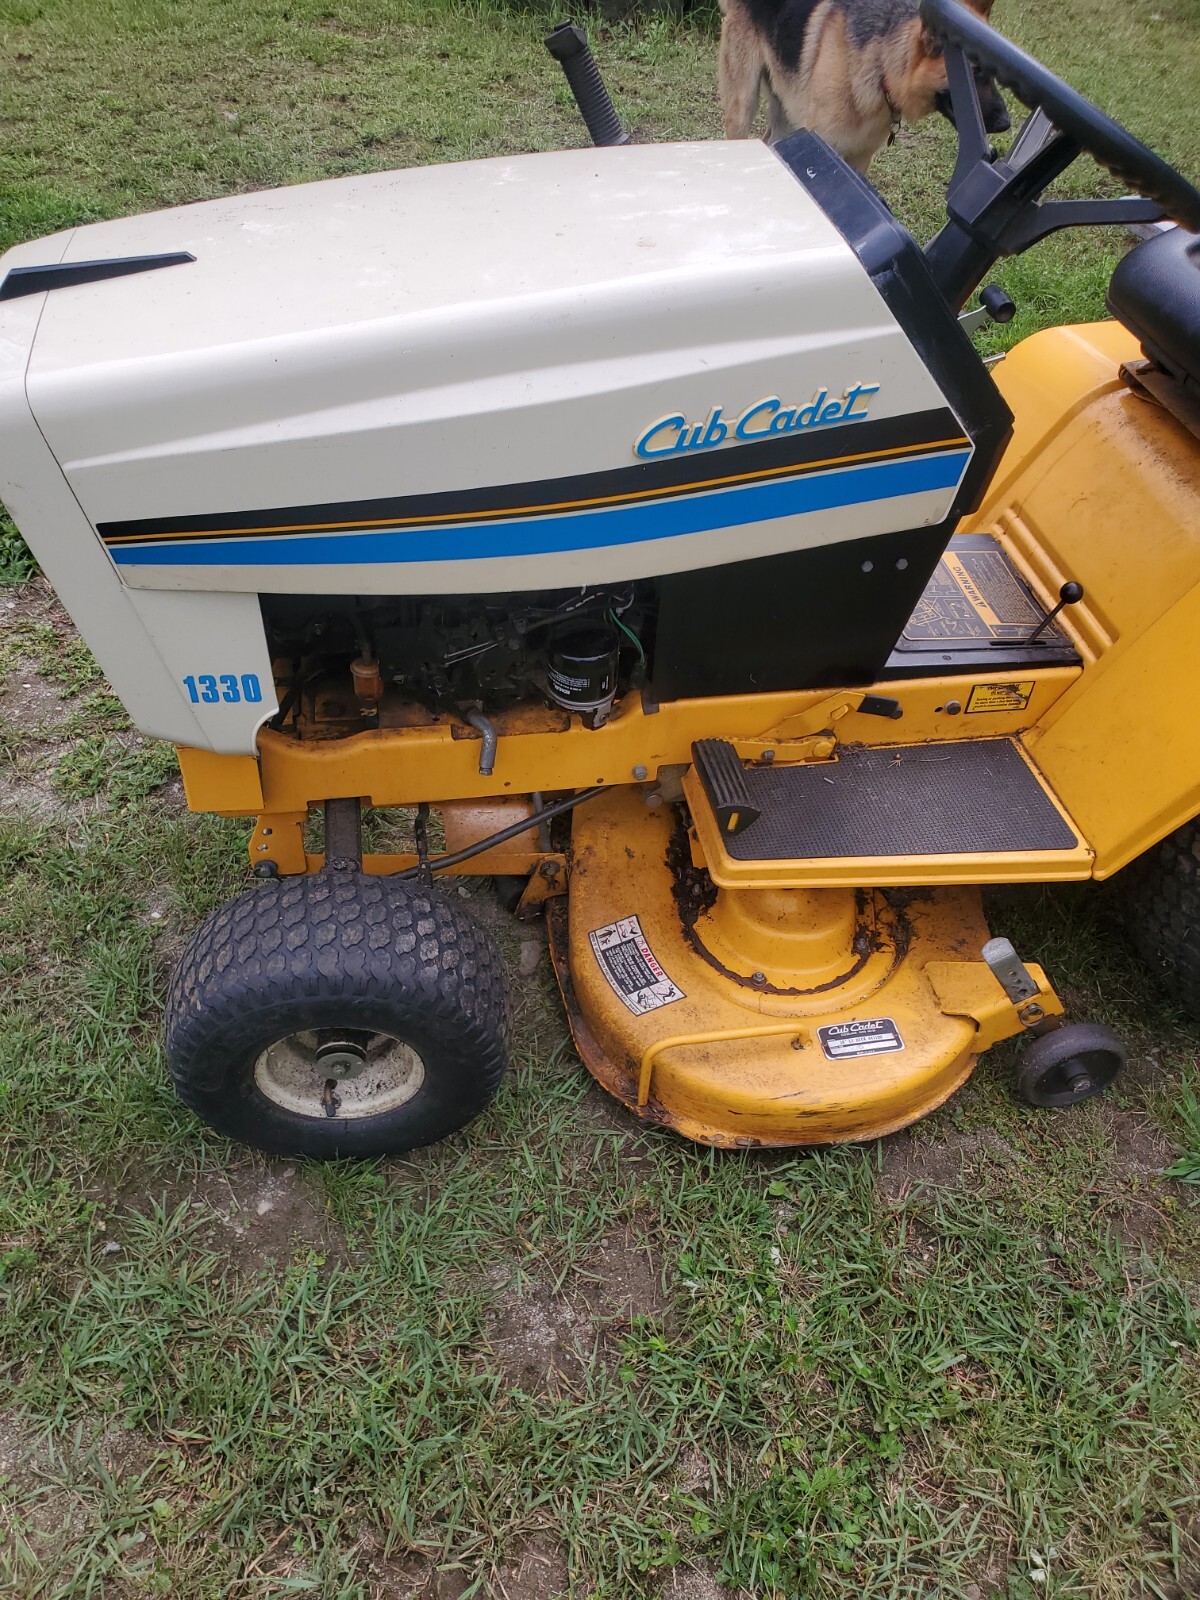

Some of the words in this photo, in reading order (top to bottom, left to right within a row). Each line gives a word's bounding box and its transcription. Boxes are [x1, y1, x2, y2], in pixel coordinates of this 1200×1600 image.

[635, 406, 729, 458] Cub
[735, 383, 880, 440] Cadet
[952, 566, 982, 603] WARNING
[183, 673, 262, 703] 1330
[640, 947, 664, 977] DANGER
[828, 1025, 849, 1035] Cub
[850, 1021, 884, 1032] Cadet
